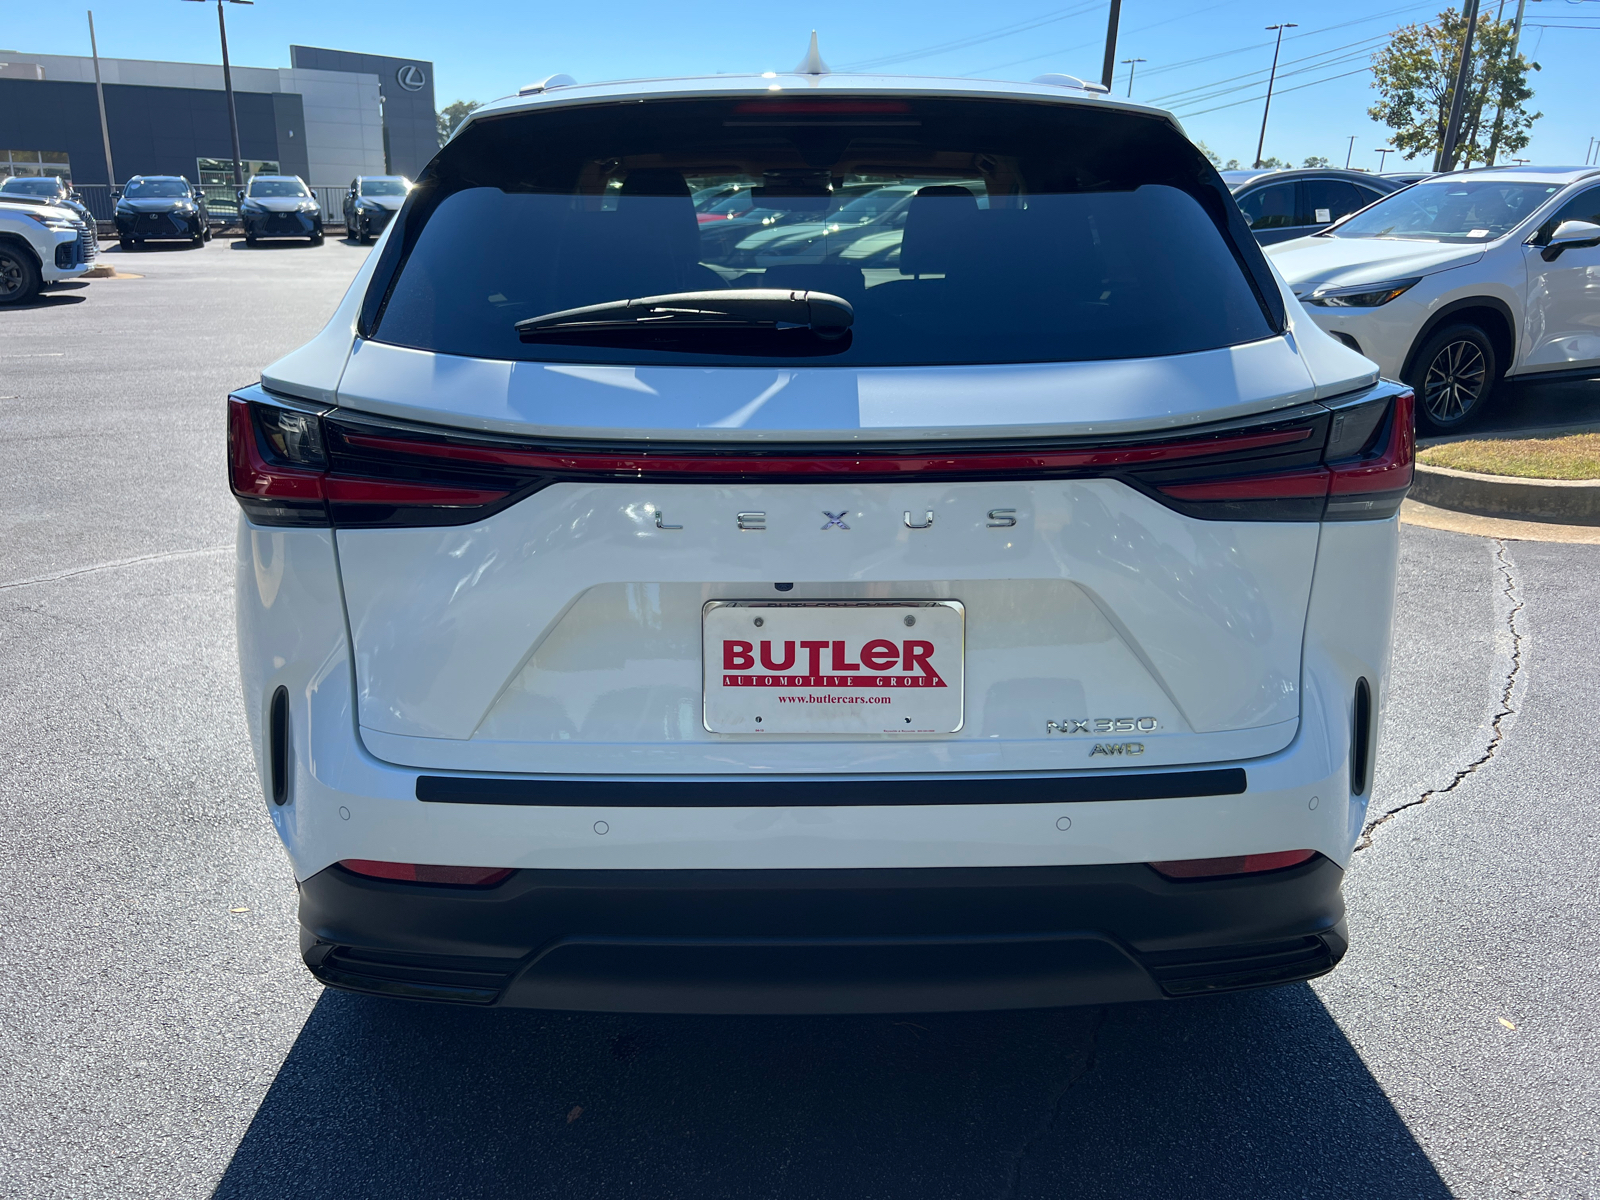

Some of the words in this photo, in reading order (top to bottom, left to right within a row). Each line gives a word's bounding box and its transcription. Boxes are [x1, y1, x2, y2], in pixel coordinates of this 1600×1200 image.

[654, 508, 1017, 530] LEXUS
[724, 676, 854, 686] AUTOMOTIVE
[876, 676, 939, 687] GROUP
[778, 694, 891, 705] www.butlercars.com
[1088, 742, 1145, 757] AWD
